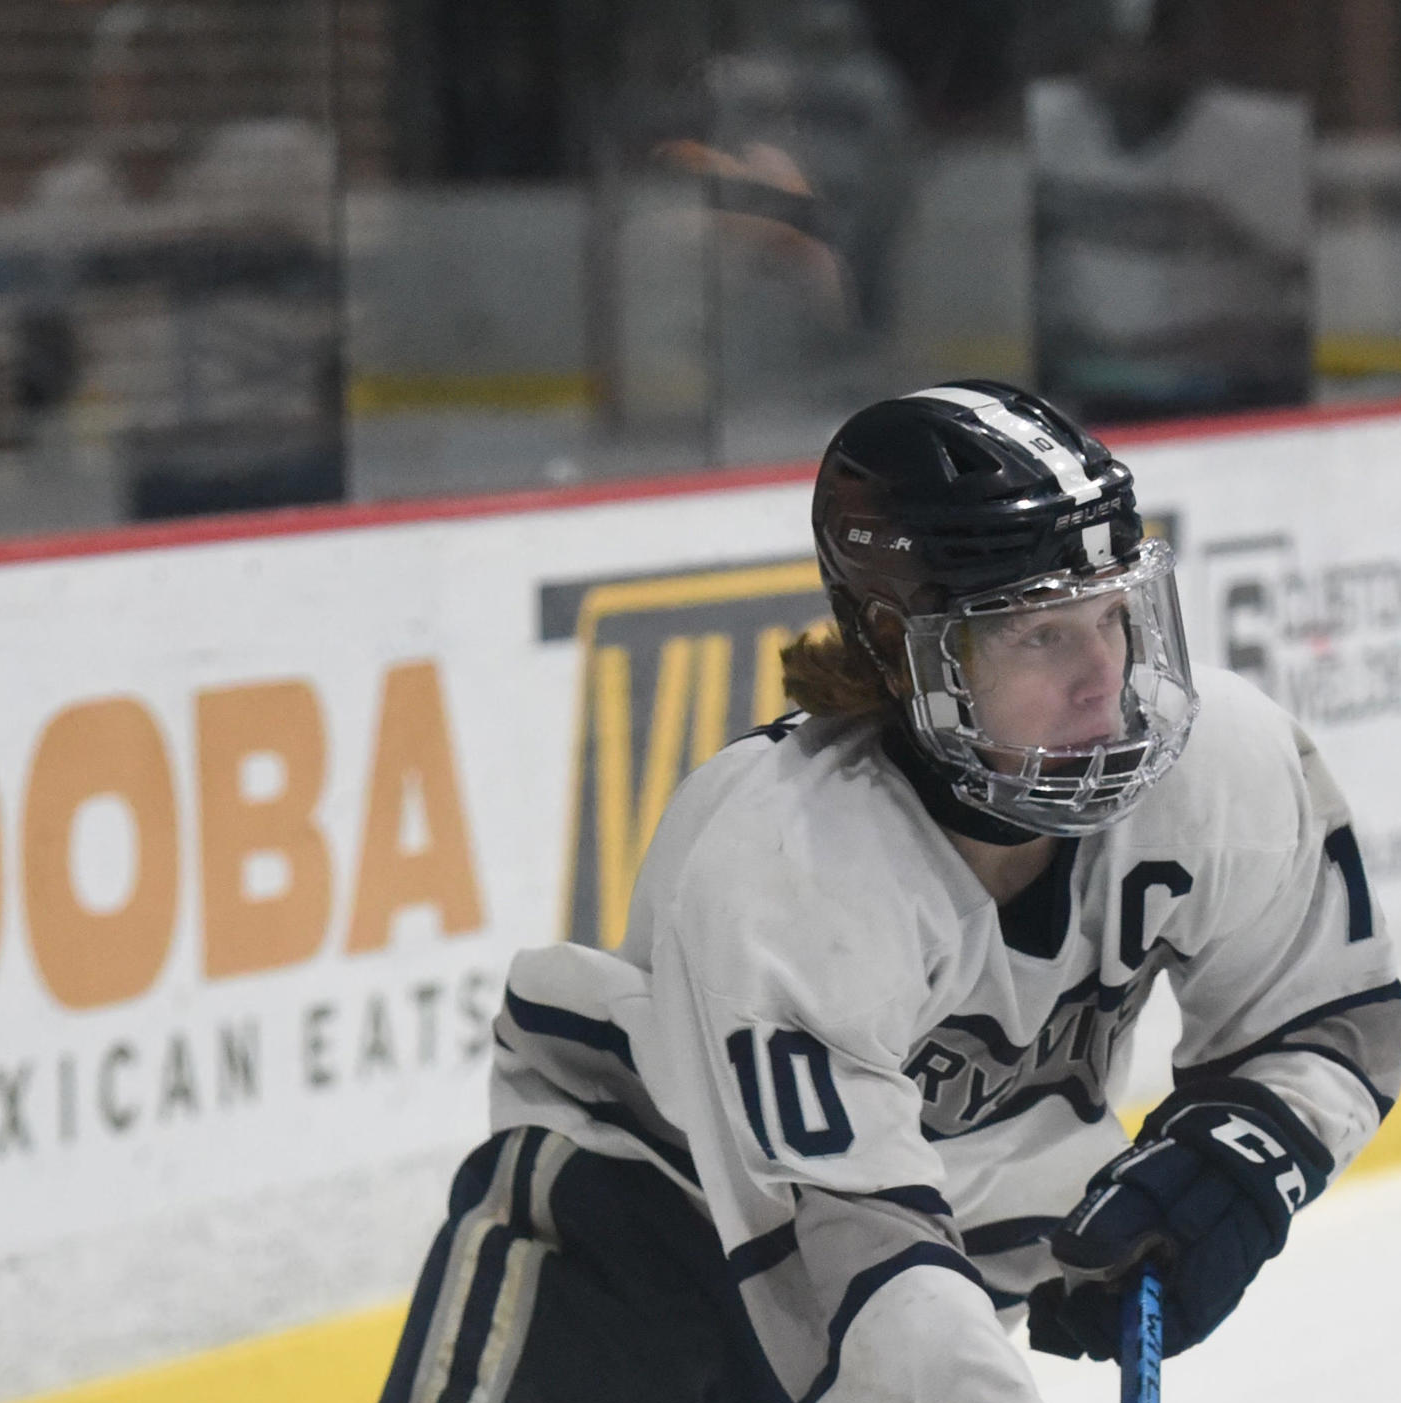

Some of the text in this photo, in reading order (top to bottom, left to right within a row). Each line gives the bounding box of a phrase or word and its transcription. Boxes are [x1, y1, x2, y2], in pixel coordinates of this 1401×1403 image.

[1029, 436, 1055, 453] 10
[848, 527, 913, 552] BAR
[1054, 498, 1122, 531] BAUER
[1121, 860, 1193, 970] C
[301, 966, 493, 1092] EATS
[726, 1028, 857, 1162] 10
